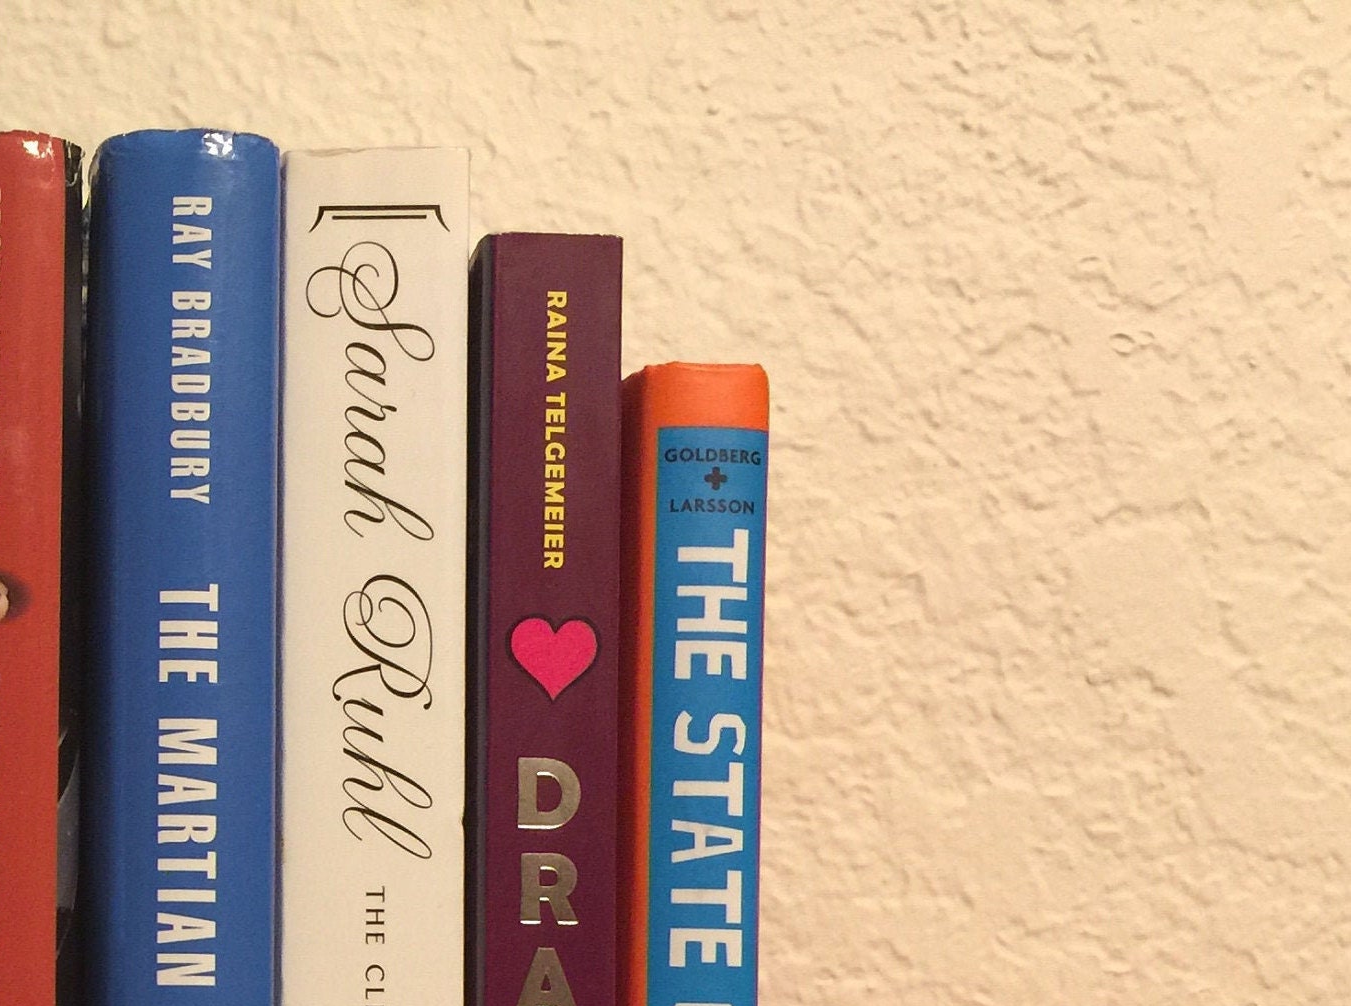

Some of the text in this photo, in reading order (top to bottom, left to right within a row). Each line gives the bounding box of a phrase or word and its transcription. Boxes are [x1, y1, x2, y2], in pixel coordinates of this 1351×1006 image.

[170, 195, 212, 505] RAY BRADBURY
[543, 291, 567, 569] RAINA TELGEMEIER
[305, 241, 435, 860] Sarah Ruhl
[664, 447, 762, 466] GOLDBERG
[669, 498, 755, 515] LARSSON
[158, 583, 219, 684] THE
[674, 528, 750, 680] THE
[155, 717, 218, 987] MARTIAN
[364, 885, 386, 946] THE
[668, 711, 747, 968] STATE
